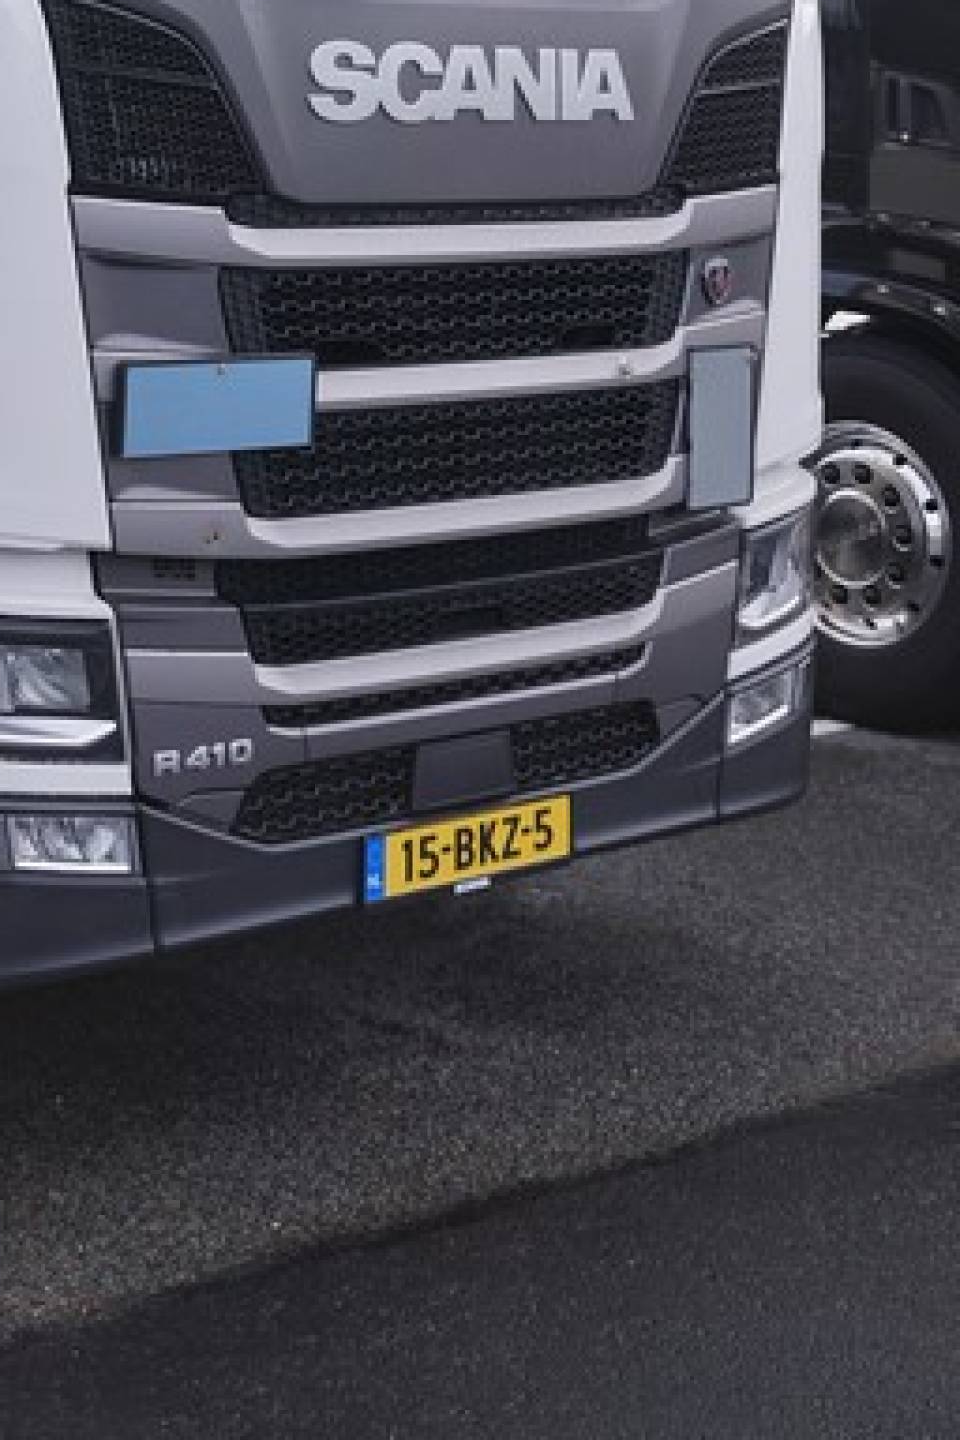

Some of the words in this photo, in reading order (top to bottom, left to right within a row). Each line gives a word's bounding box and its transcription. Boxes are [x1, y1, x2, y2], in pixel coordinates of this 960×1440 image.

[306, 40, 635, 122] SCANIA
[153, 748, 181, 776] R
[186, 737, 252, 770] 410
[401, 806, 556, 882] 15-BKZ-5
